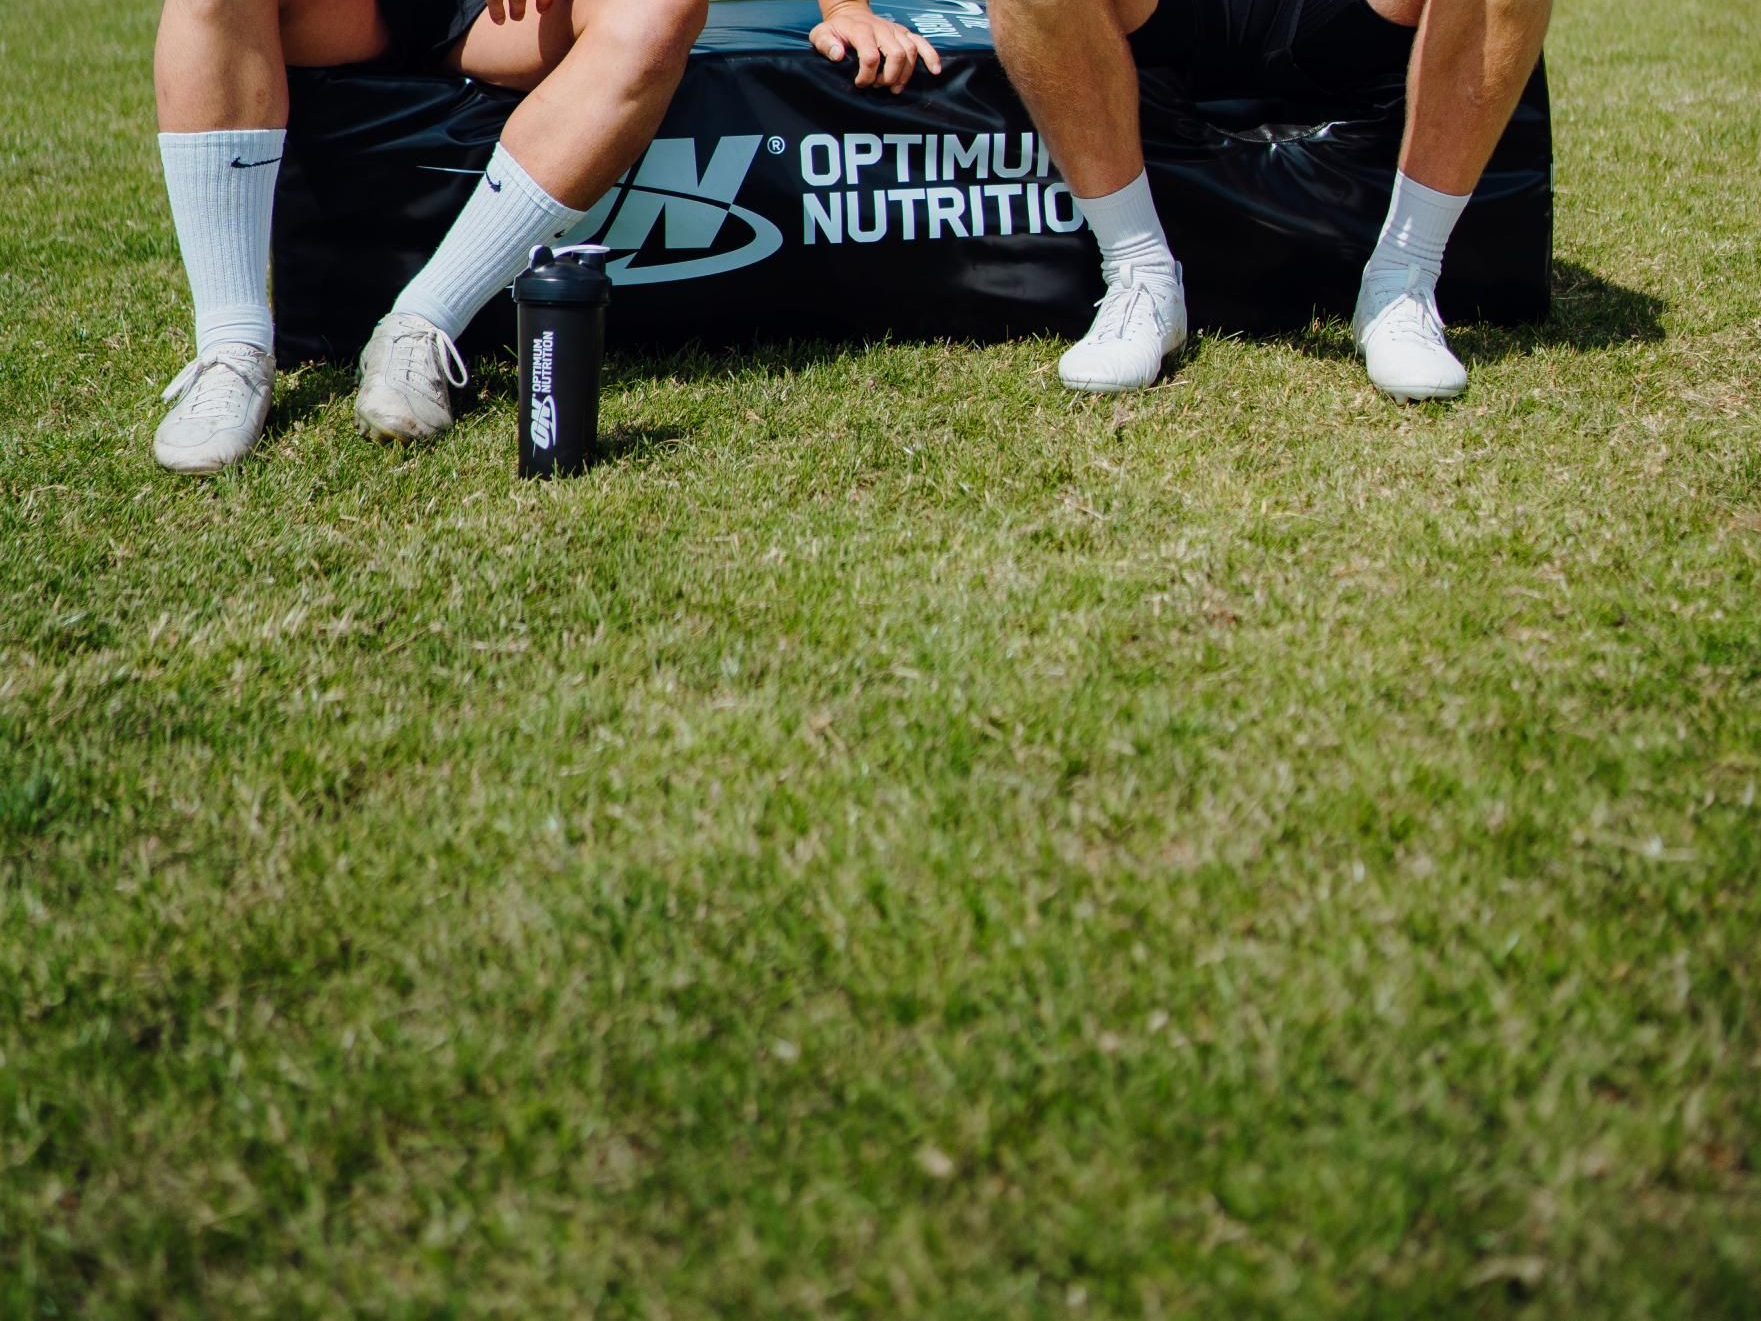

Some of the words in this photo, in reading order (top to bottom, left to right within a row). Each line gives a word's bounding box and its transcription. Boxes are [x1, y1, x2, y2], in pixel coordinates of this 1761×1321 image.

[906, 13, 963, 38] RUGBY
[802, 182, 1093, 245] NUTRITIO
[532, 338, 543, 392] OPTIMUM
[541, 331, 554, 393] NUTRITION
[531, 396, 557, 451] ON
